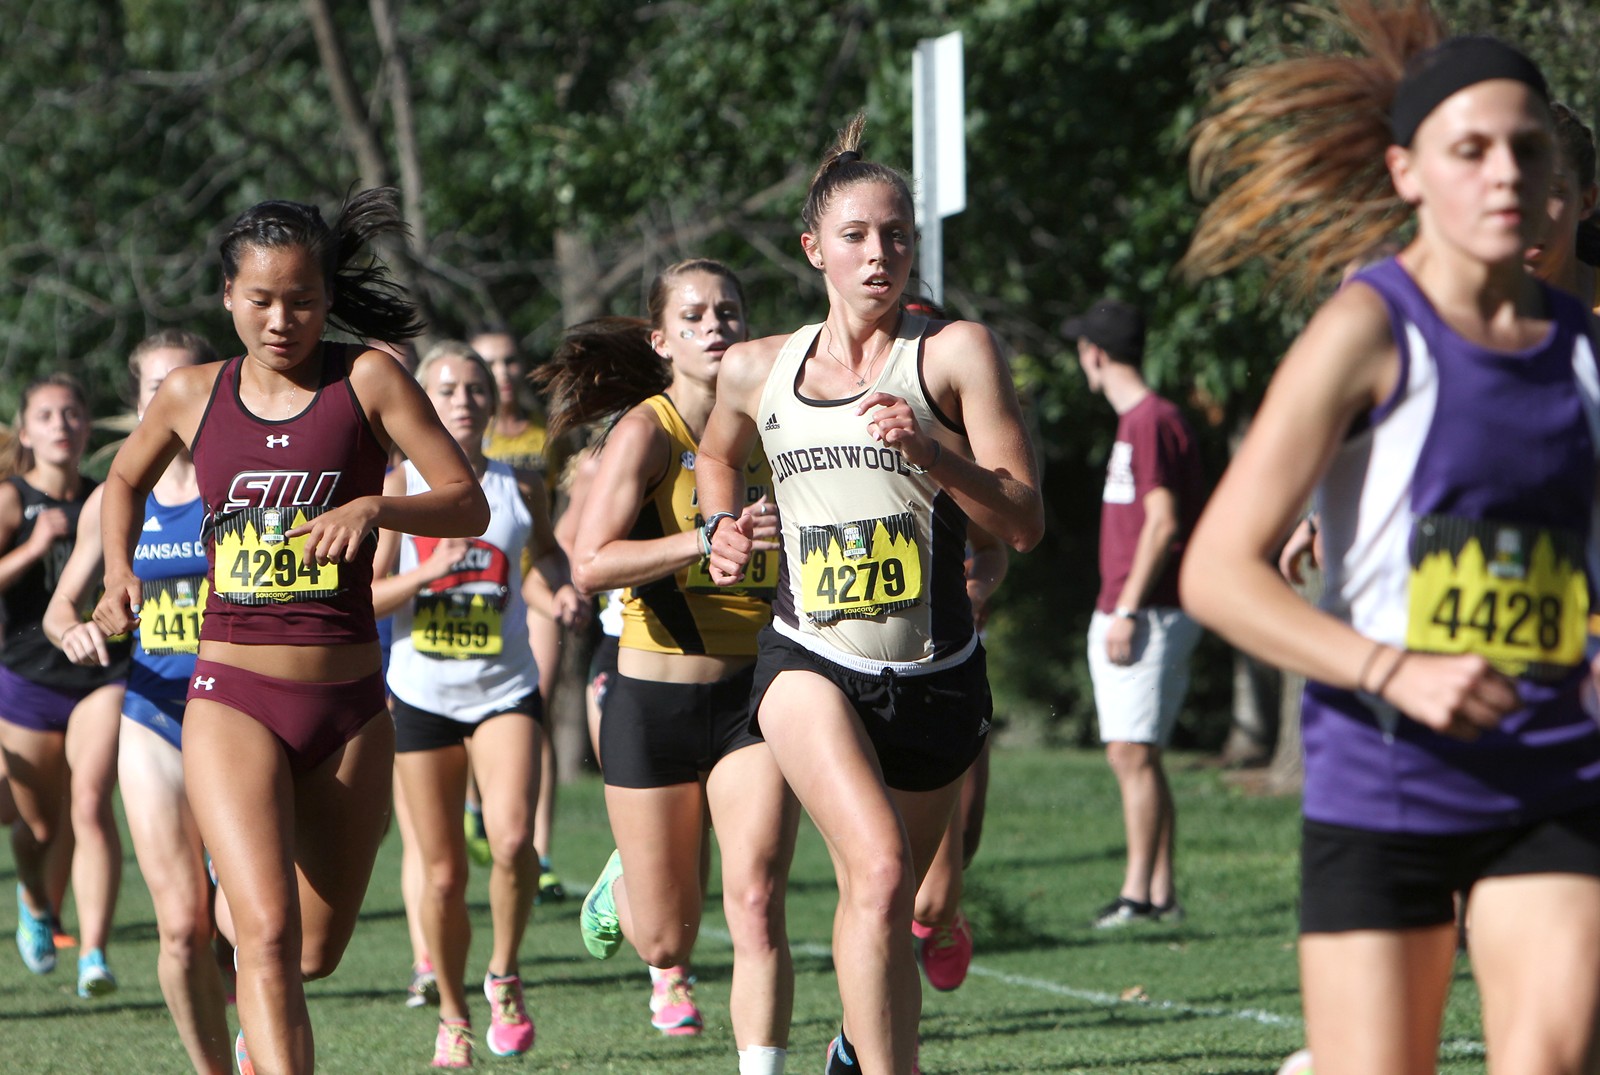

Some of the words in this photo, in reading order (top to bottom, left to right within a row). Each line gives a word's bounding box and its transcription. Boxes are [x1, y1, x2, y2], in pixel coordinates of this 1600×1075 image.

[224, 471, 341, 514] SIU
[230, 549, 321, 587] 4294
[816, 557, 906, 605] 4279
[256, 591, 287, 599] saucony
[843, 605, 876, 615] saucony
[424, 621, 489, 648] 4459
[1432, 587, 1562, 651] 4428
